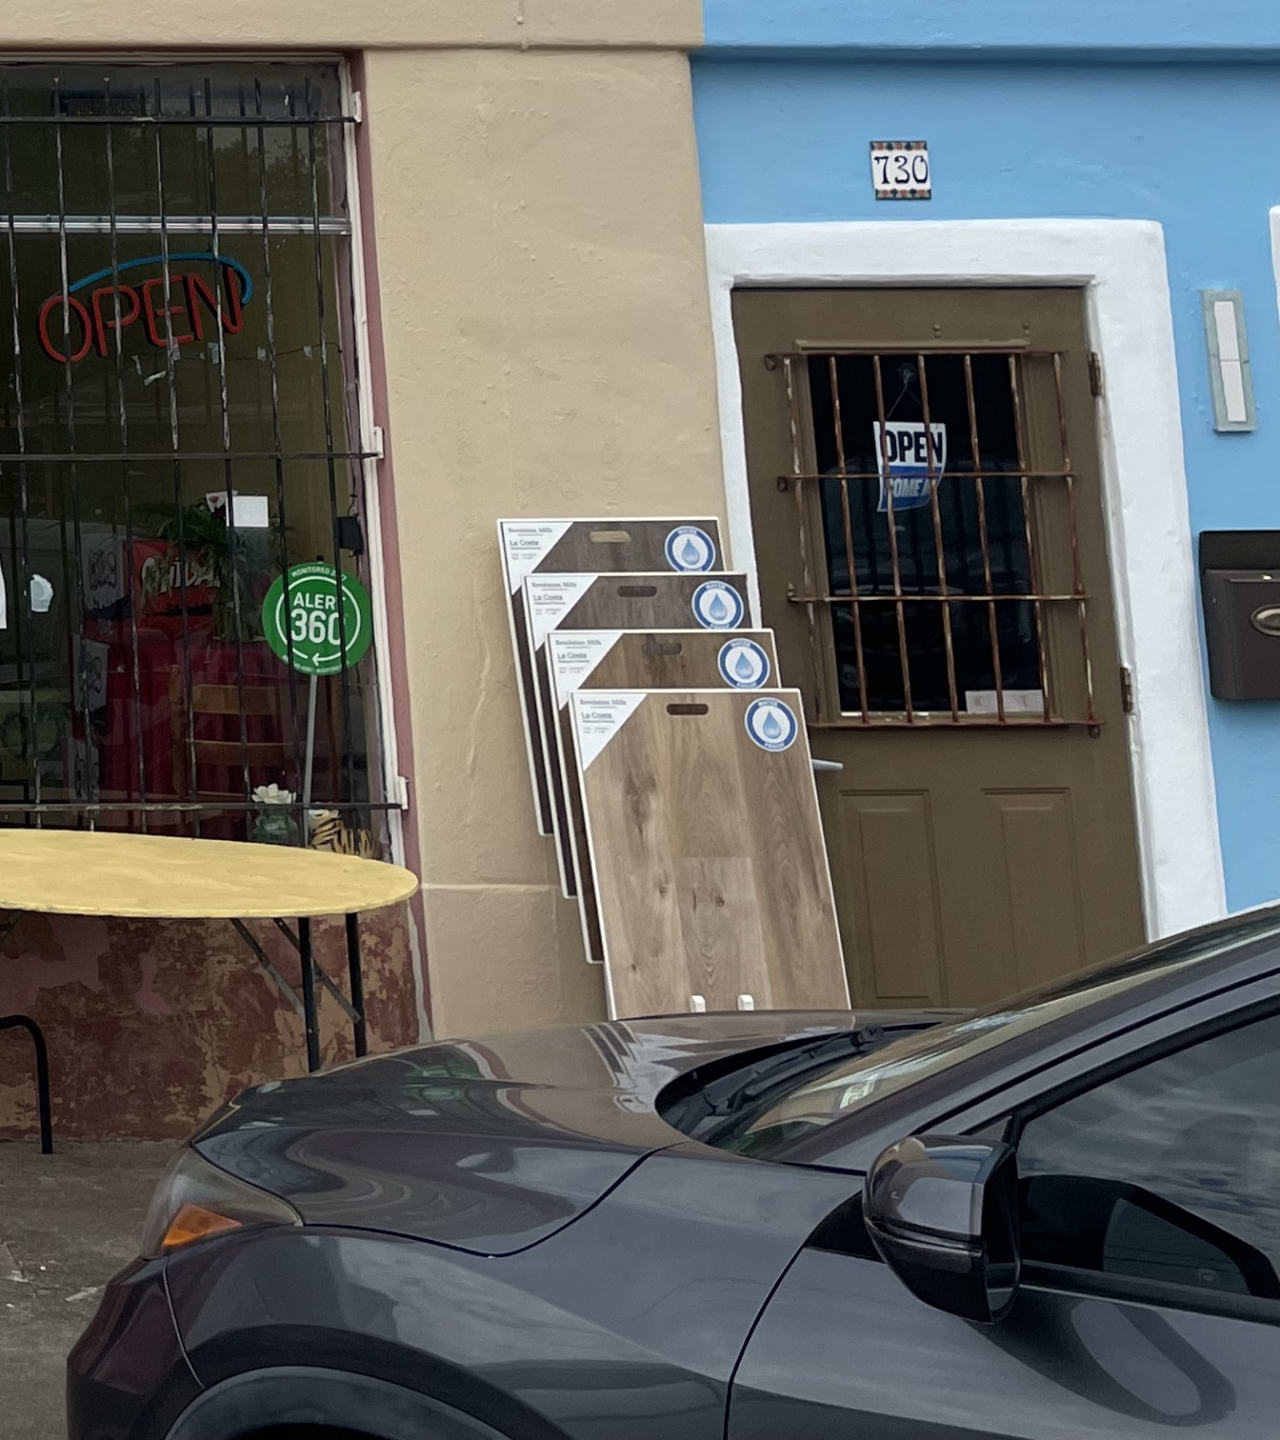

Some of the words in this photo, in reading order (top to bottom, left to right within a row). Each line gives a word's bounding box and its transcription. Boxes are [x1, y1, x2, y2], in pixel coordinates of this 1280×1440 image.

[874, 155, 929, 185] 730
[39, 266, 244, 364] OPEN
[879, 430, 943, 464] OPEN
[293, 591, 345, 610] ALER
[290, 608, 343, 646] 360
